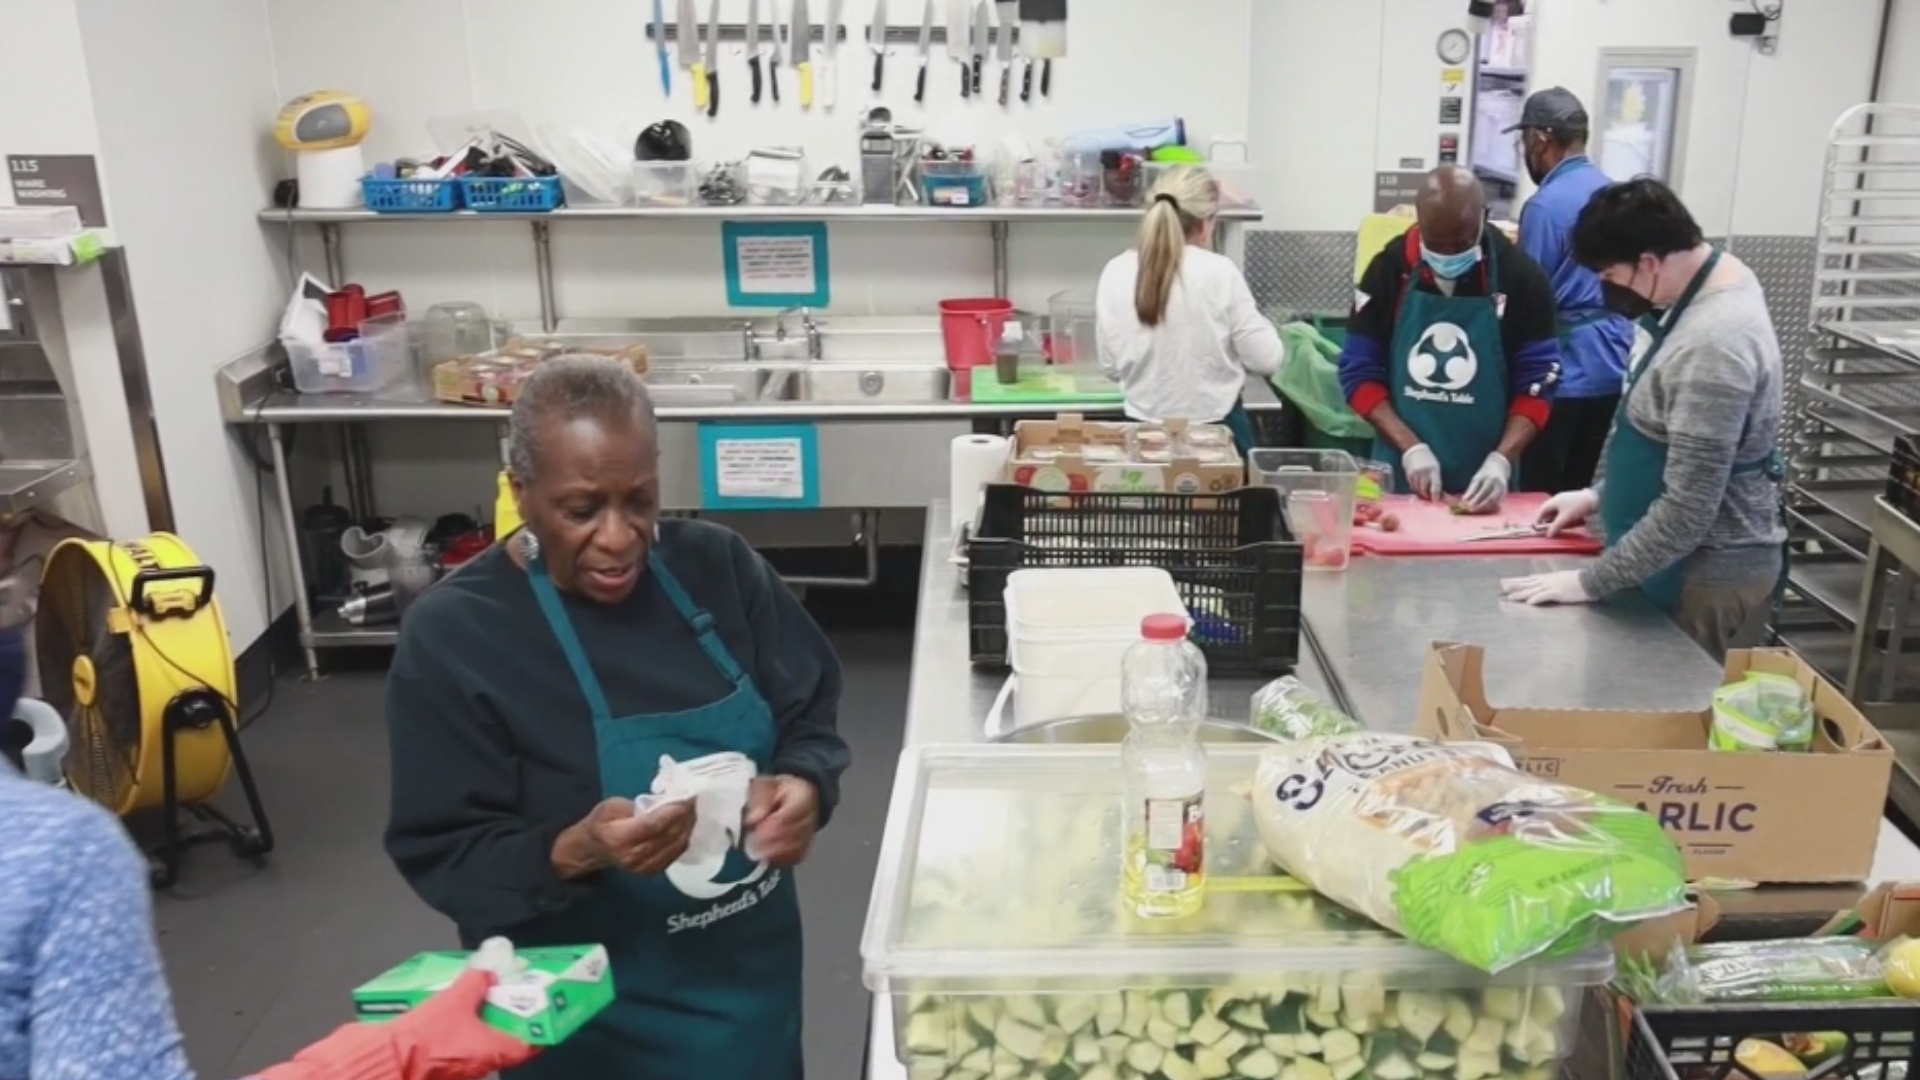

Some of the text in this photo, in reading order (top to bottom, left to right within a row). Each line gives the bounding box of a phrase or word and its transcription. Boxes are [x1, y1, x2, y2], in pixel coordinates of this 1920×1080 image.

[11, 159, 39, 172] 115
[1648, 774, 1708, 795] Fresh
[1636, 801, 1758, 833] RLIC
[666, 889, 758, 934] Shepherd's
